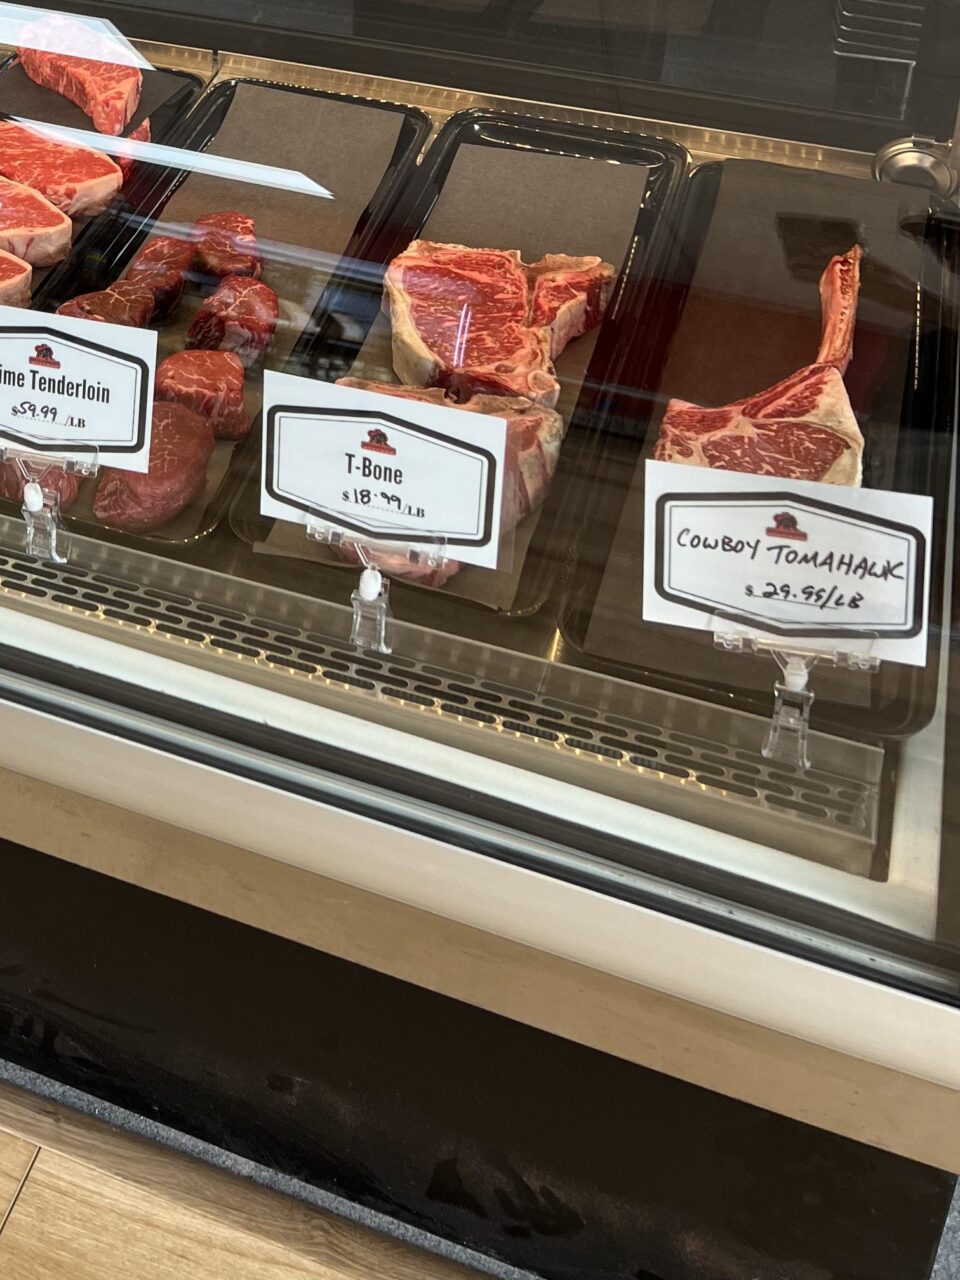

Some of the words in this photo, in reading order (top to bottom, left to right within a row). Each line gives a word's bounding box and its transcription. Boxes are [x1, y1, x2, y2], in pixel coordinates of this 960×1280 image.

[29, 369, 110, 404] Tenderloin
[345, 452, 403, 485] T-Bone
[676, 527, 762, 560] COWBOY
[766, 544, 905, 582] TOMAHAWK
